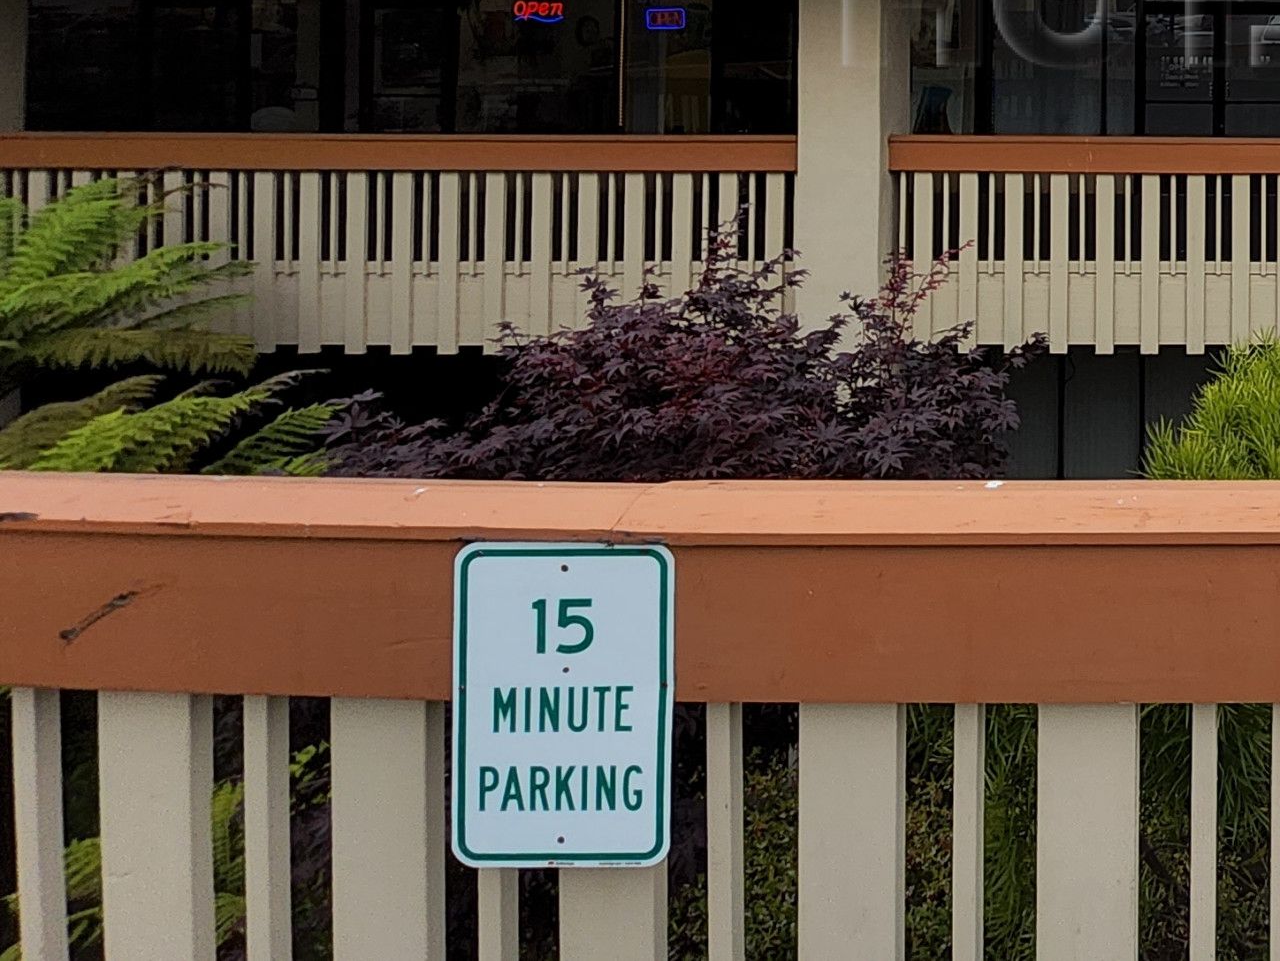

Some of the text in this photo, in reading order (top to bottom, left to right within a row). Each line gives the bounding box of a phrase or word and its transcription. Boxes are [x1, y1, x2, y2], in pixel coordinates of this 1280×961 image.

[513, 0, 564, 21] Open
[531, 598, 594, 654] 15
[492, 685, 634, 733] MINUTE
[478, 765, 643, 812] PARKING
